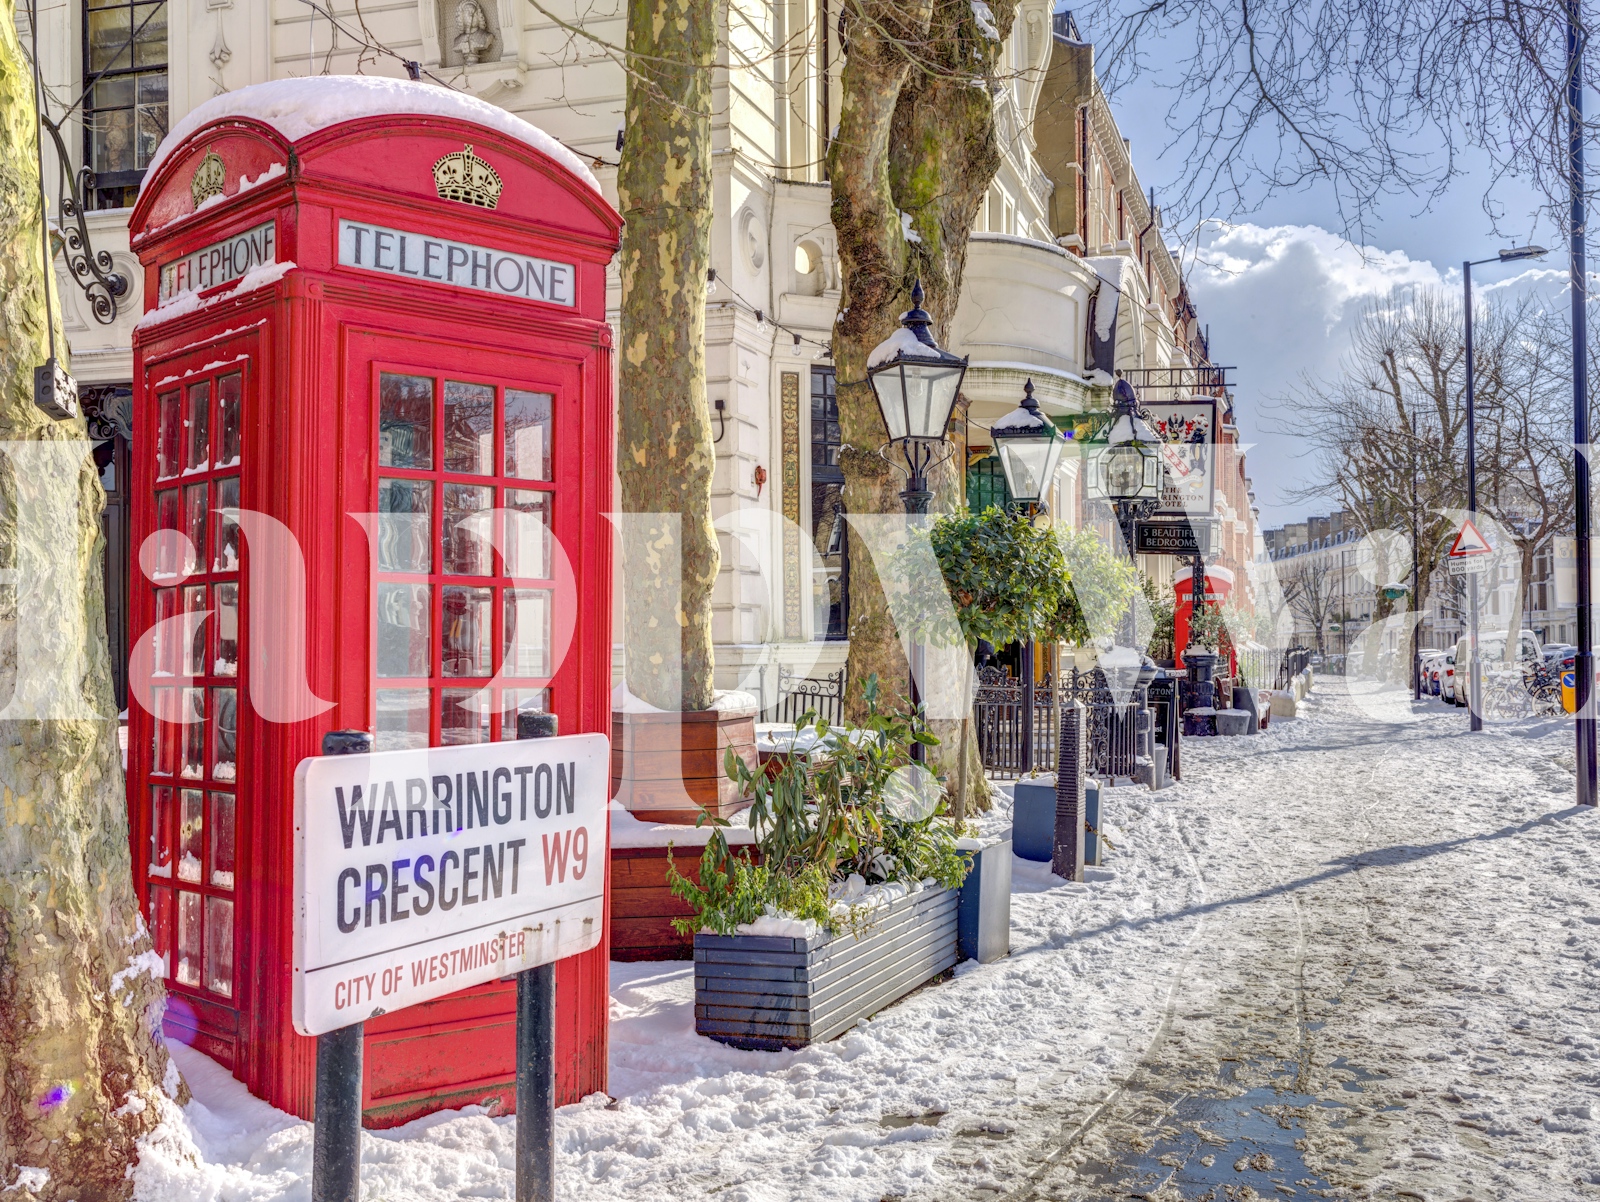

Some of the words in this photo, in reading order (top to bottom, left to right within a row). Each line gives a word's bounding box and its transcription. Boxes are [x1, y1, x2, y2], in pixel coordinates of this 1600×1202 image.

[346, 225, 568, 303] TELEPHONE
[1146, 538, 1198, 548] BEDROOMS
[1151, 528, 1201, 538] BEAUTIFUL
[334, 761, 576, 850] WARRINGTON
[336, 838, 527, 934] CRESCENT
[541, 826, 589, 886] W9
[334, 971, 377, 1010] CITY
[381, 965, 404, 996] OF
[411, 931, 526, 988] WESTMINSTER
